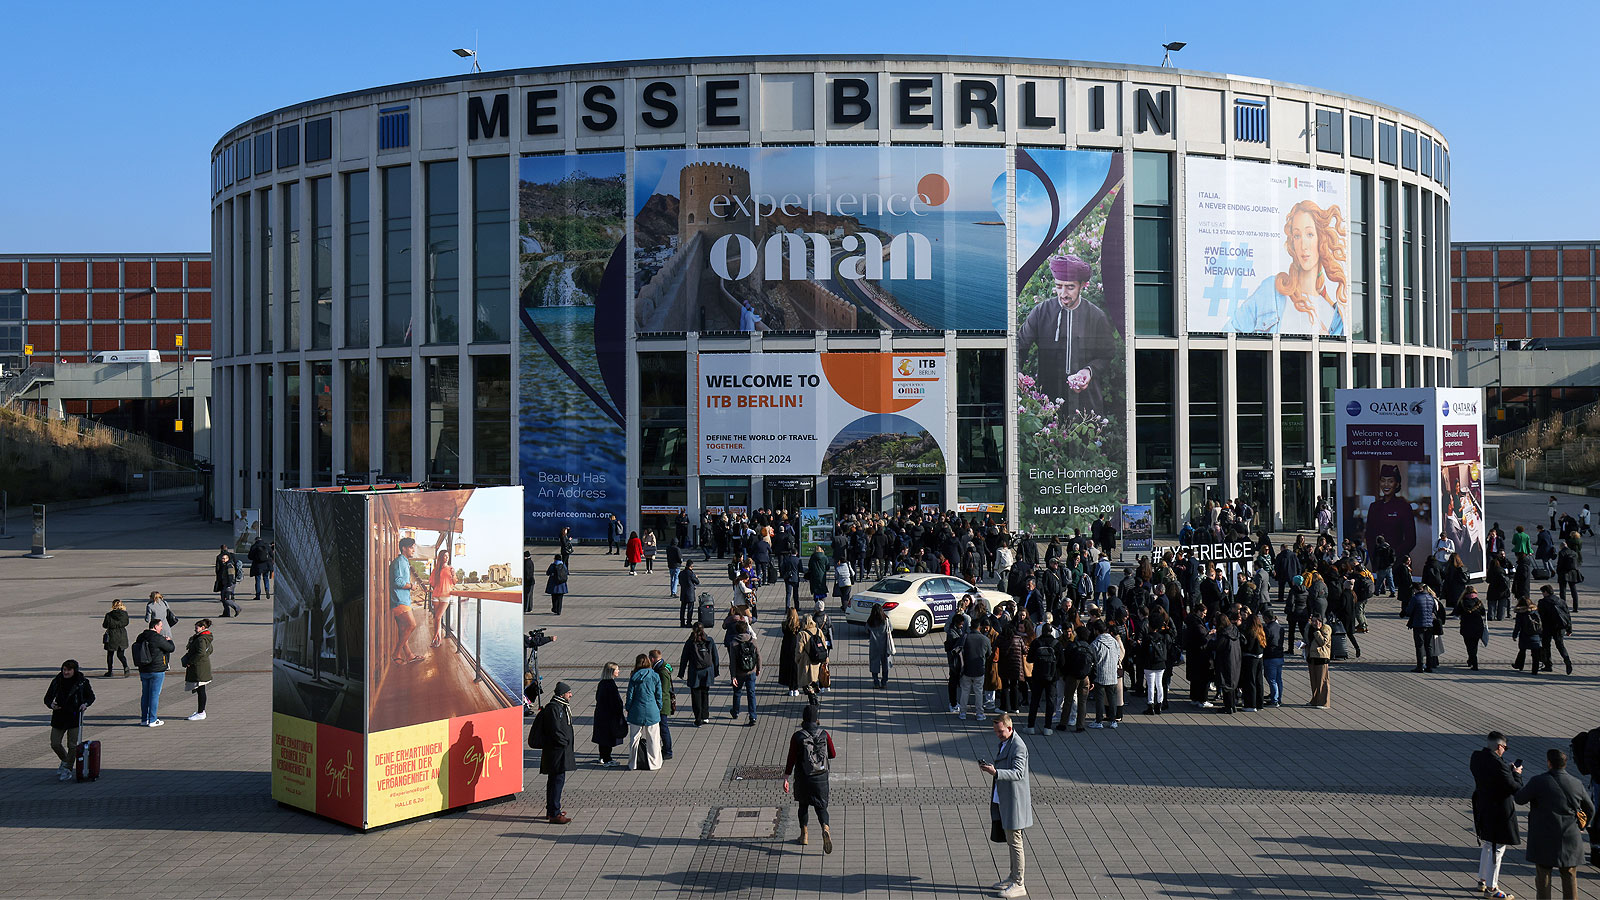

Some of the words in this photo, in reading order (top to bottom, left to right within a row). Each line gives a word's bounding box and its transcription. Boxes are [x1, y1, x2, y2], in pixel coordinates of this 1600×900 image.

[468, 79, 741, 140] MESSE
[833, 78, 1171, 135] BERLIN
[1198, 191, 1221, 200] ITALIA.
[709, 185, 932, 226] experience
[1204, 202, 1226, 210] NEVER
[1228, 204, 1251, 212] ENDING
[1252, 206, 1280, 214] JOURNEY.
[709, 232, 932, 281] oman
[1204, 246, 1254, 258] #WELCOME
[1204, 256, 1216, 266] TO
[1204, 266, 1256, 277] MERAVIGLIA
[918, 359, 936, 368] ITB
[706, 374, 793, 388] WELCOME
[798, 374, 820, 388] TO
[706, 395, 732, 408] ITB
[737, 394, 804, 408] BERLIN!
[1370, 402, 1408, 414] QATAR
[1453, 402, 1470, 414] QATAR
[1382, 439, 1418, 447] excellence
[706, 456, 712, 464] 5
[722, 456, 728, 464] 7
[730, 456, 766, 464] MARCH
[768, 455, 792, 464] 2024
[538, 471, 580, 486] Beauty
[583, 472, 606, 484] Has
[1030, 468, 1054, 480] Eine
[1057, 468, 1118, 480] Hommage
[538, 486, 554, 498] An
[557, 487, 606, 498] Address
[1040, 486, 1062, 495] ans
[1064, 482, 1108, 494] Erleben
[1034, 506, 1051, 515] Hall
[1052, 506, 1066, 514] 2.2
[1074, 506, 1098, 514] Booth
[1100, 505, 1115, 513] 201
[934, 604, 952, 612] oman
[418, 756, 432, 770] DER
[394, 800, 412, 808] HALLE
